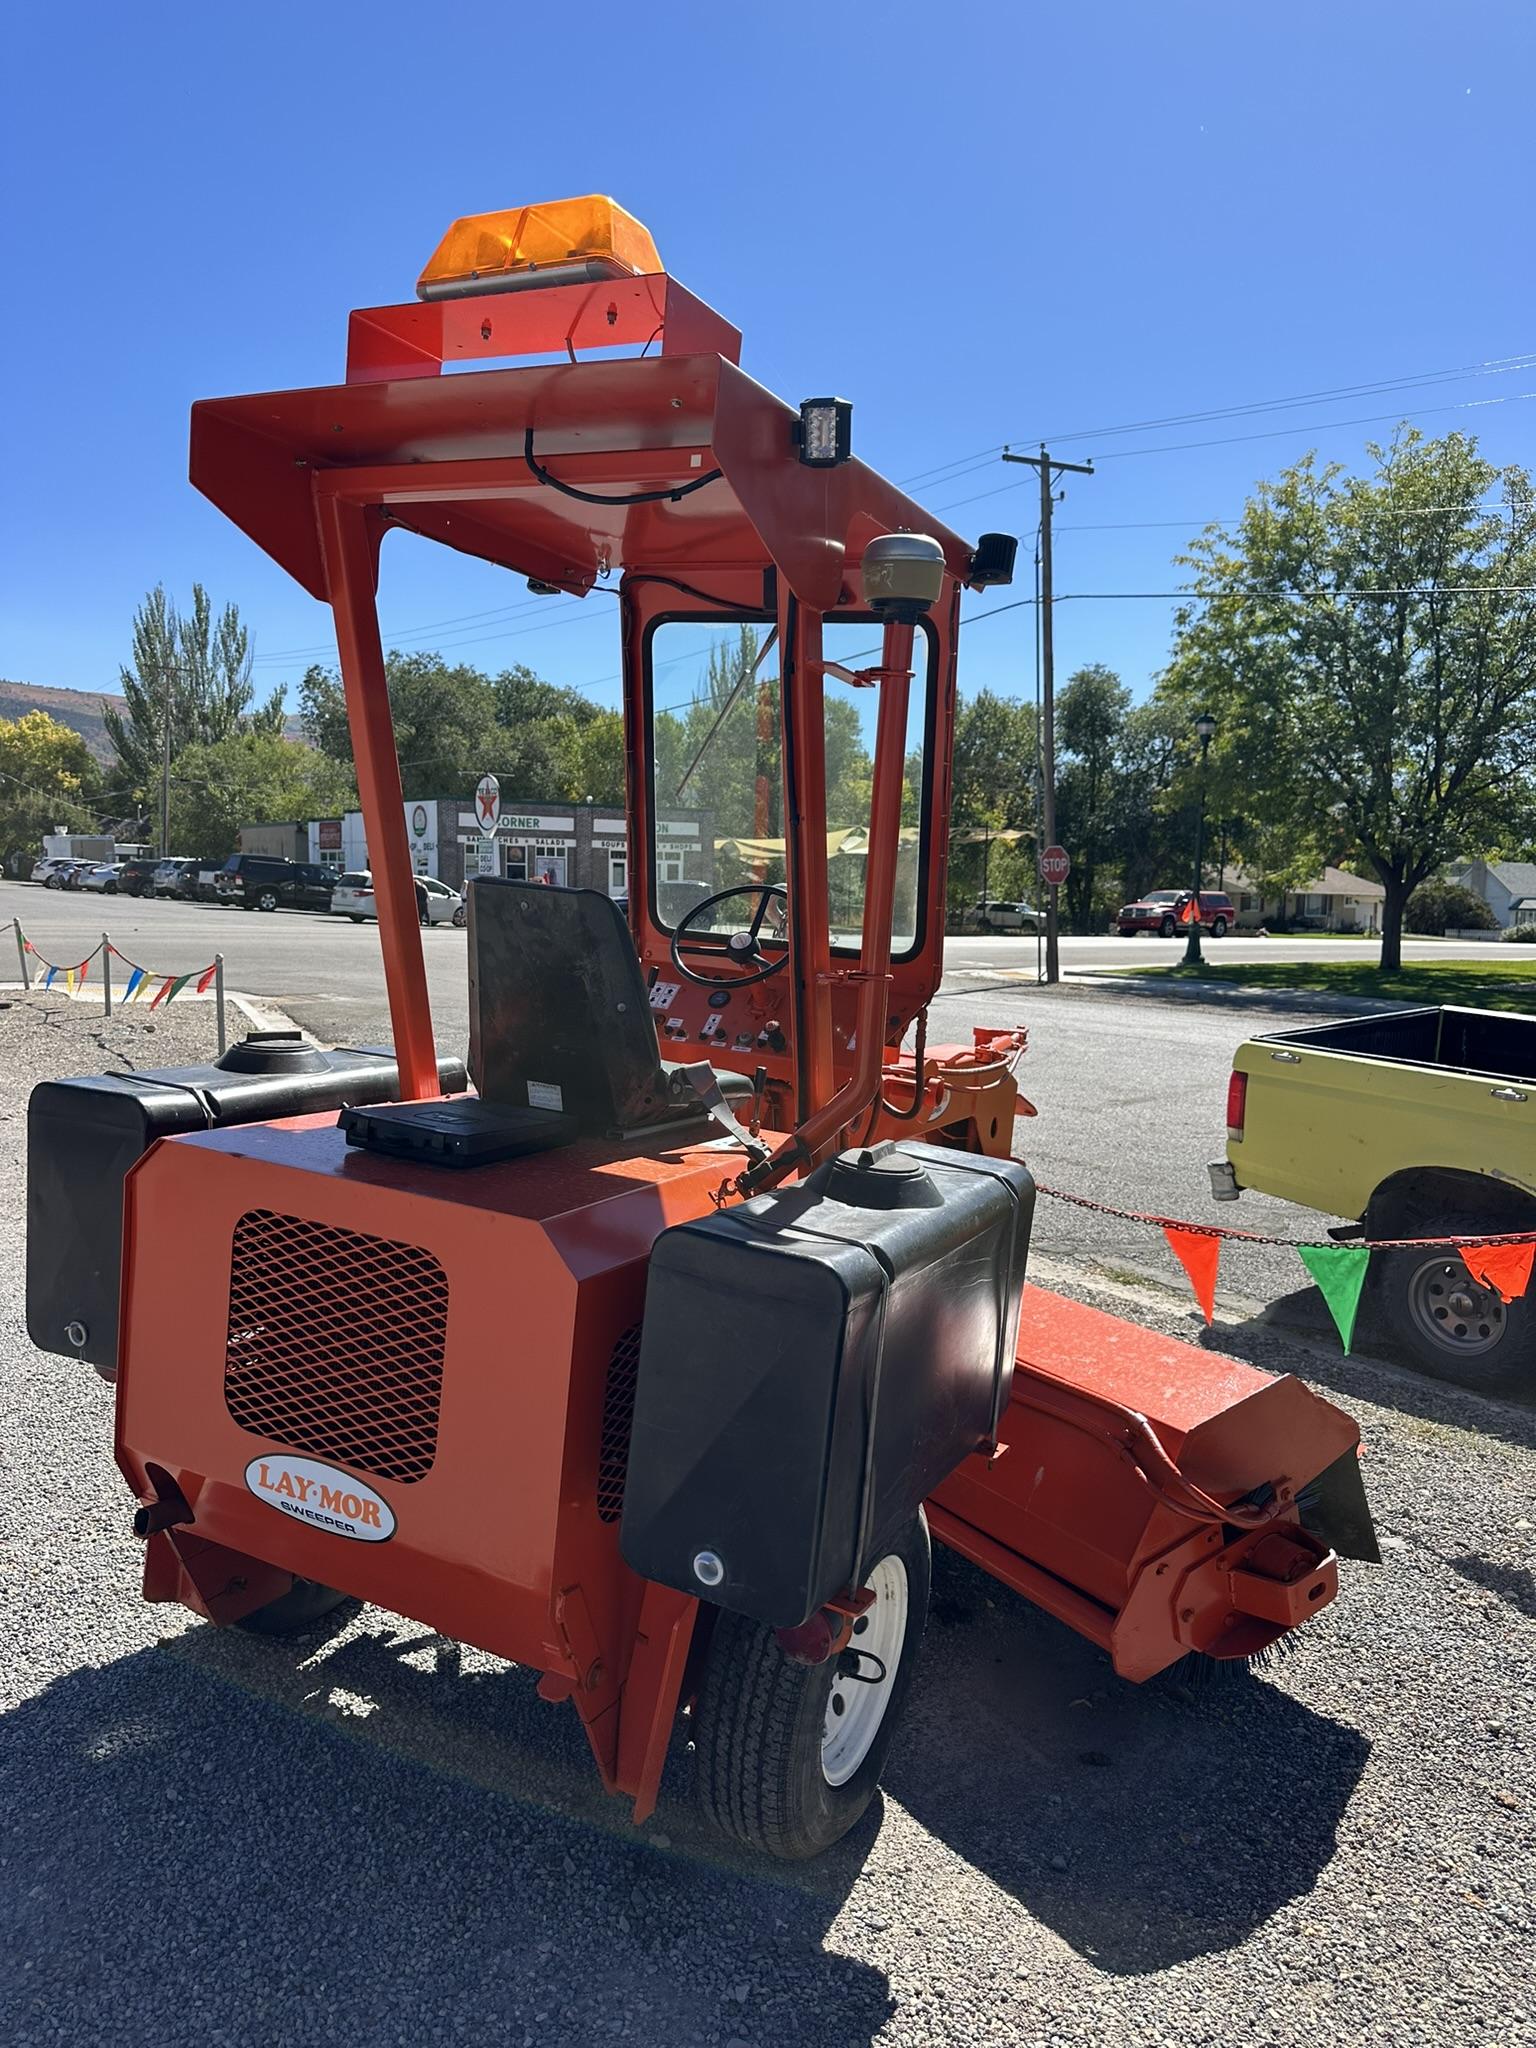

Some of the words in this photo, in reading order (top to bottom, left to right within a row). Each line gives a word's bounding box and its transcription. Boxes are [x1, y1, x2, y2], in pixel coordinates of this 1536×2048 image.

[498, 817, 540, 828] ORNER
[466, 836, 519, 844] SANCHES
[1043, 858, 1067, 872] STOP
[280, 1500, 357, 1535] SWEEPER
